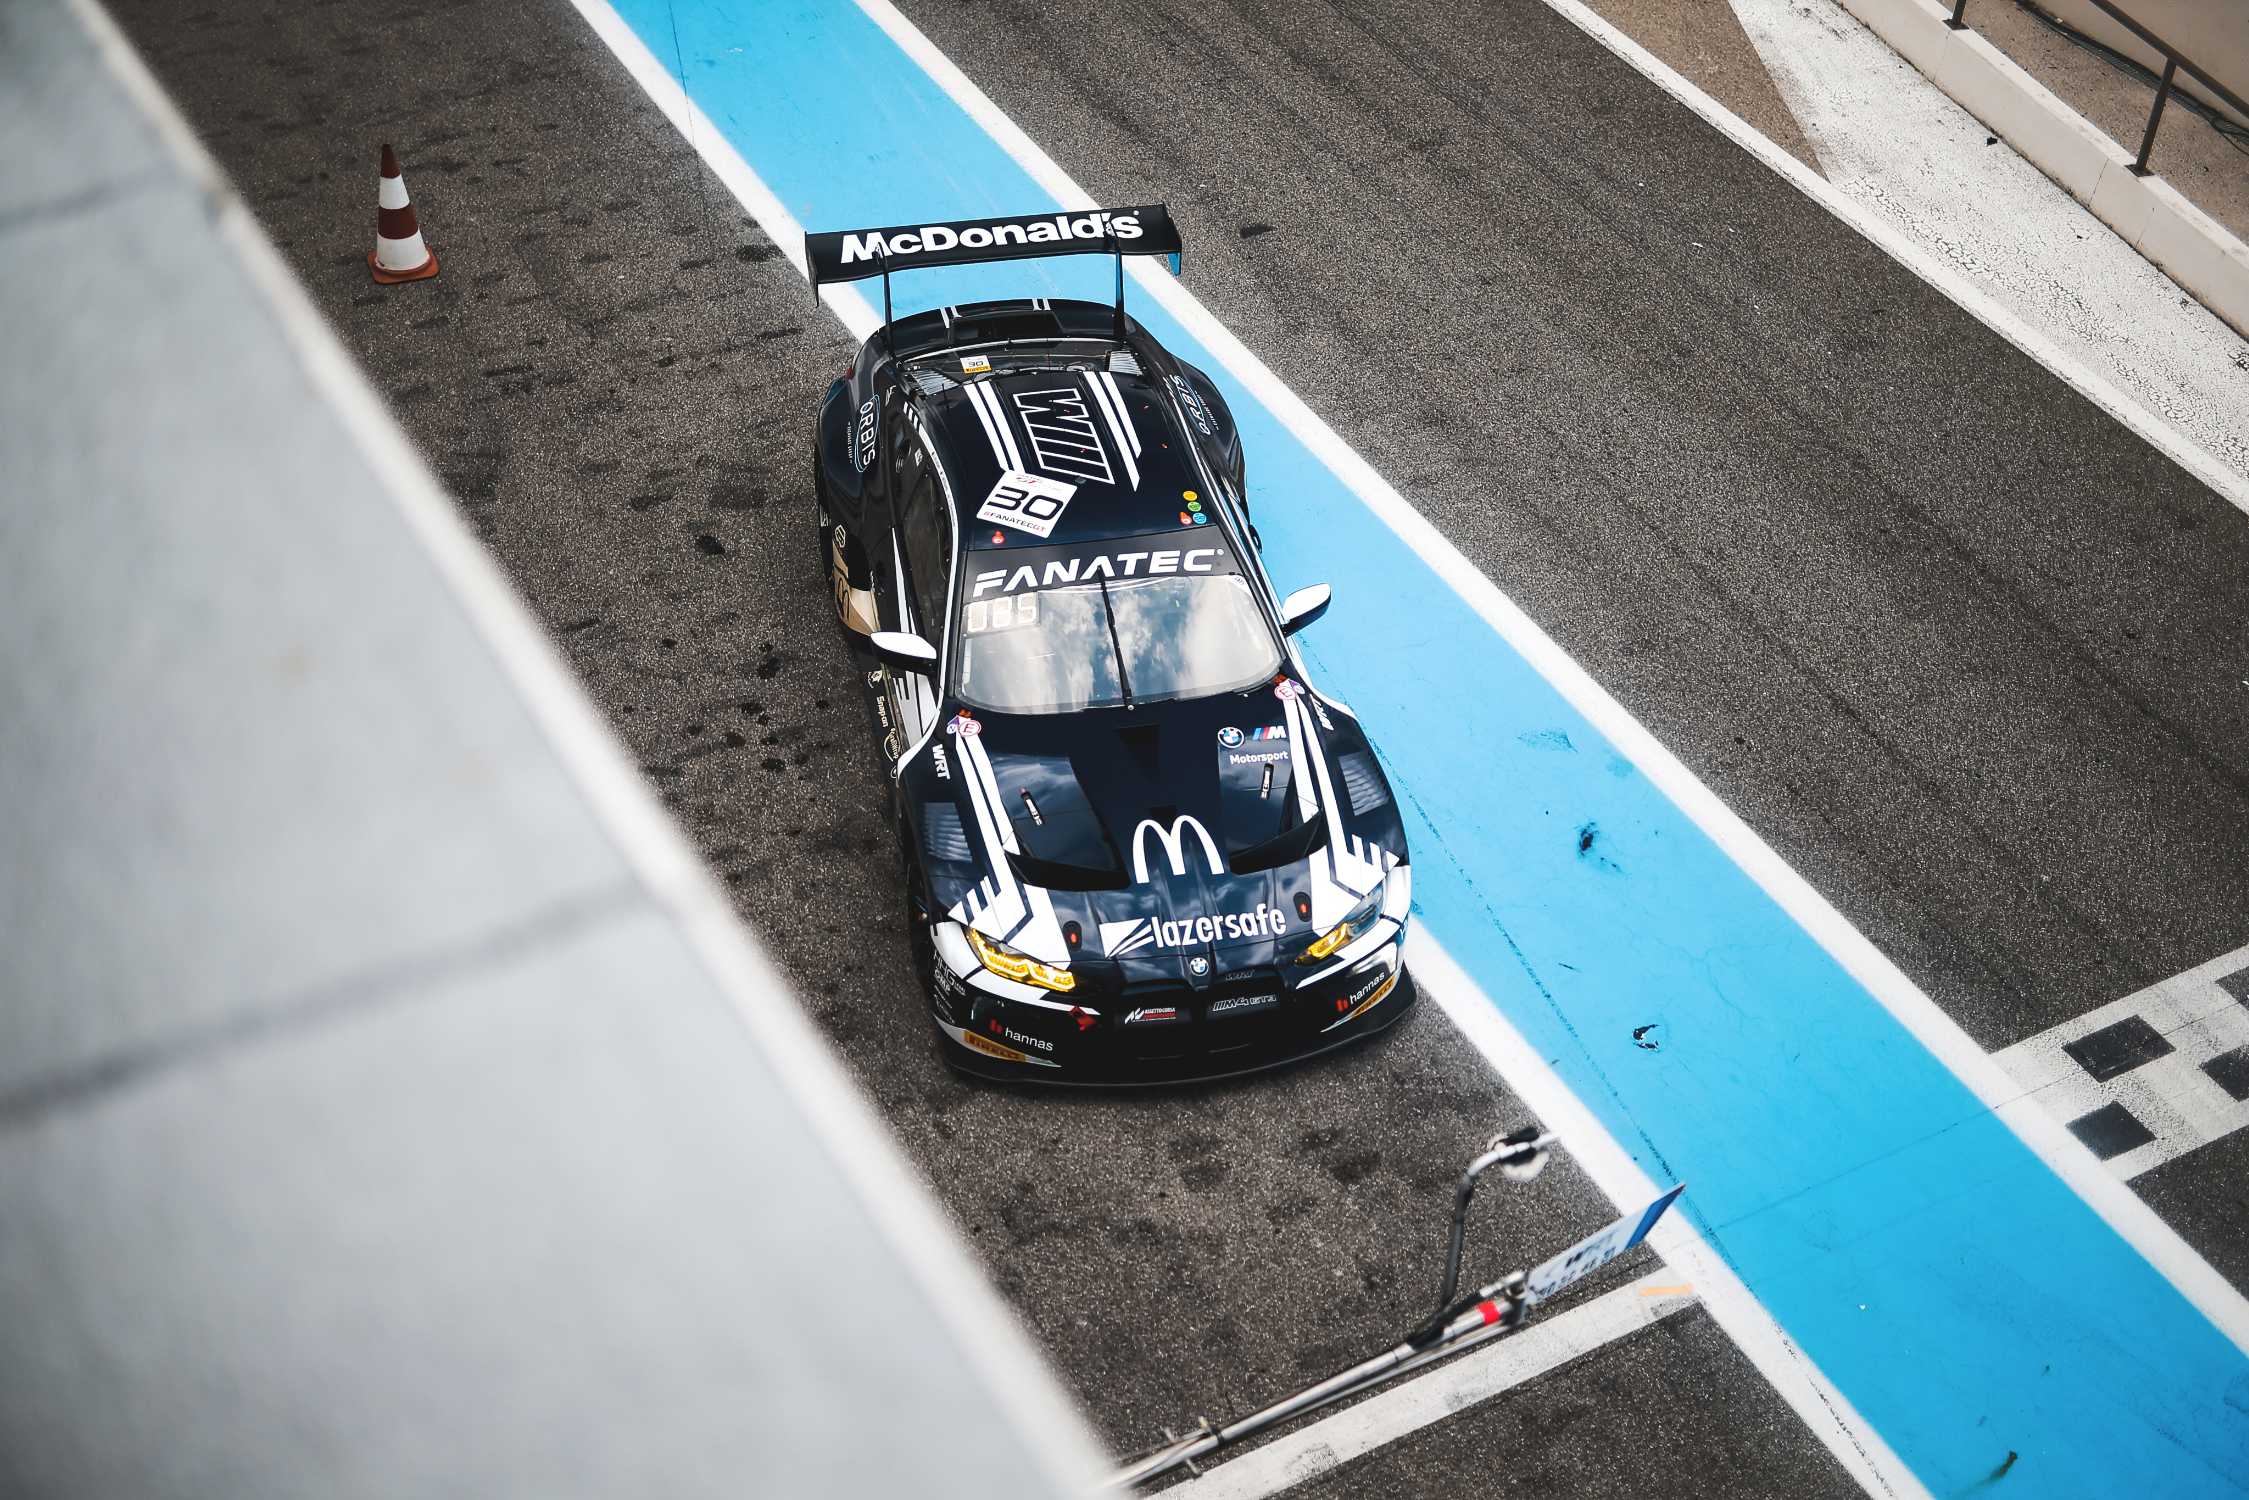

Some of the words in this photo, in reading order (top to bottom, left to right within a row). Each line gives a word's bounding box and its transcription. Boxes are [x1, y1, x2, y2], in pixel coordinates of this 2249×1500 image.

[841, 213, 1144, 263] McDonald's
[860, 402, 875, 465] ORBIS
[987, 486, 1064, 520] 30
[973, 549, 1215, 597] FANATEC
[932, 744, 950, 779] WRT
[1230, 751, 1288, 764] Motorsport
[1152, 903, 1286, 948] lazersafe
[1349, 972, 1385, 1004] hannas
[1005, 1027, 1054, 1051] hannas
